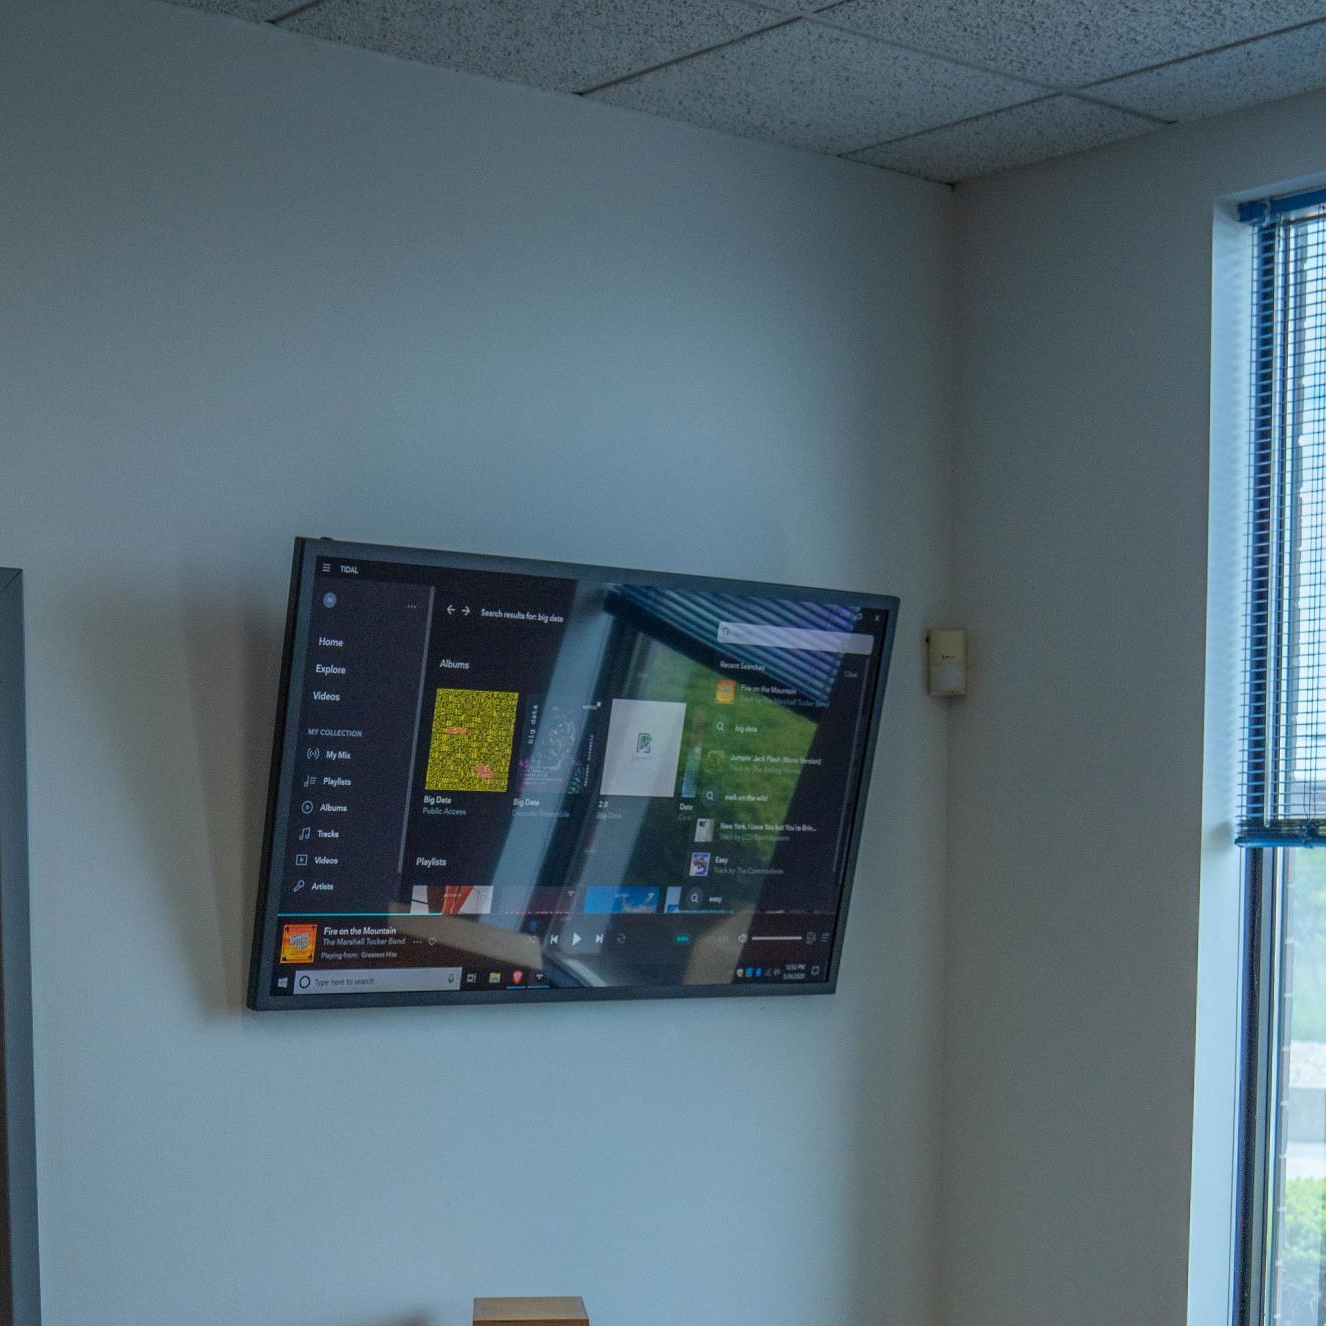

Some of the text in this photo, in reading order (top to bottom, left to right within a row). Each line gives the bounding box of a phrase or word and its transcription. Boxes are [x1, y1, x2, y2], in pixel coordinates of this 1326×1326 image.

[340, 565, 359, 574] TIDAL
[481, 608, 564, 624] Search results for: big data
[318, 637, 344, 647] Home
[439, 659, 470, 670] Albums
[719, 660, 766, 672] Recent Searches
[316, 664, 346, 676] Explore
[740, 684, 752, 692] Fire
[771, 686, 797, 695] Mountain
[313, 691, 341, 701] Videos
[307, 728, 363, 738] MY COLLECTION
[326, 751, 351, 761] My Mix
[323, 777, 352, 787] Playlists
[423, 795, 452, 805] Big Data
[513, 798, 540, 808] Big Data
[598, 800, 609, 808] 2.0
[320, 803, 348, 813] Albums
[422, 807, 467, 816] Public Access
[317, 829, 339, 839] Tracks
[314, 856, 338, 866] Videos
[415, 857, 447, 868] Playlists
[714, 856, 729, 866] Easy
[311, 882, 334, 891] Artists
[323, 926, 397, 936] Fire on the Mountain
[323, 938, 336, 946] The
[336, 937, 365, 945] Marshall
[388, 937, 406, 945] Band
[321, 951, 343, 960] Playing
[360, 951, 385, 959] Greatest
[314, 976, 375, 988] Type here to search
